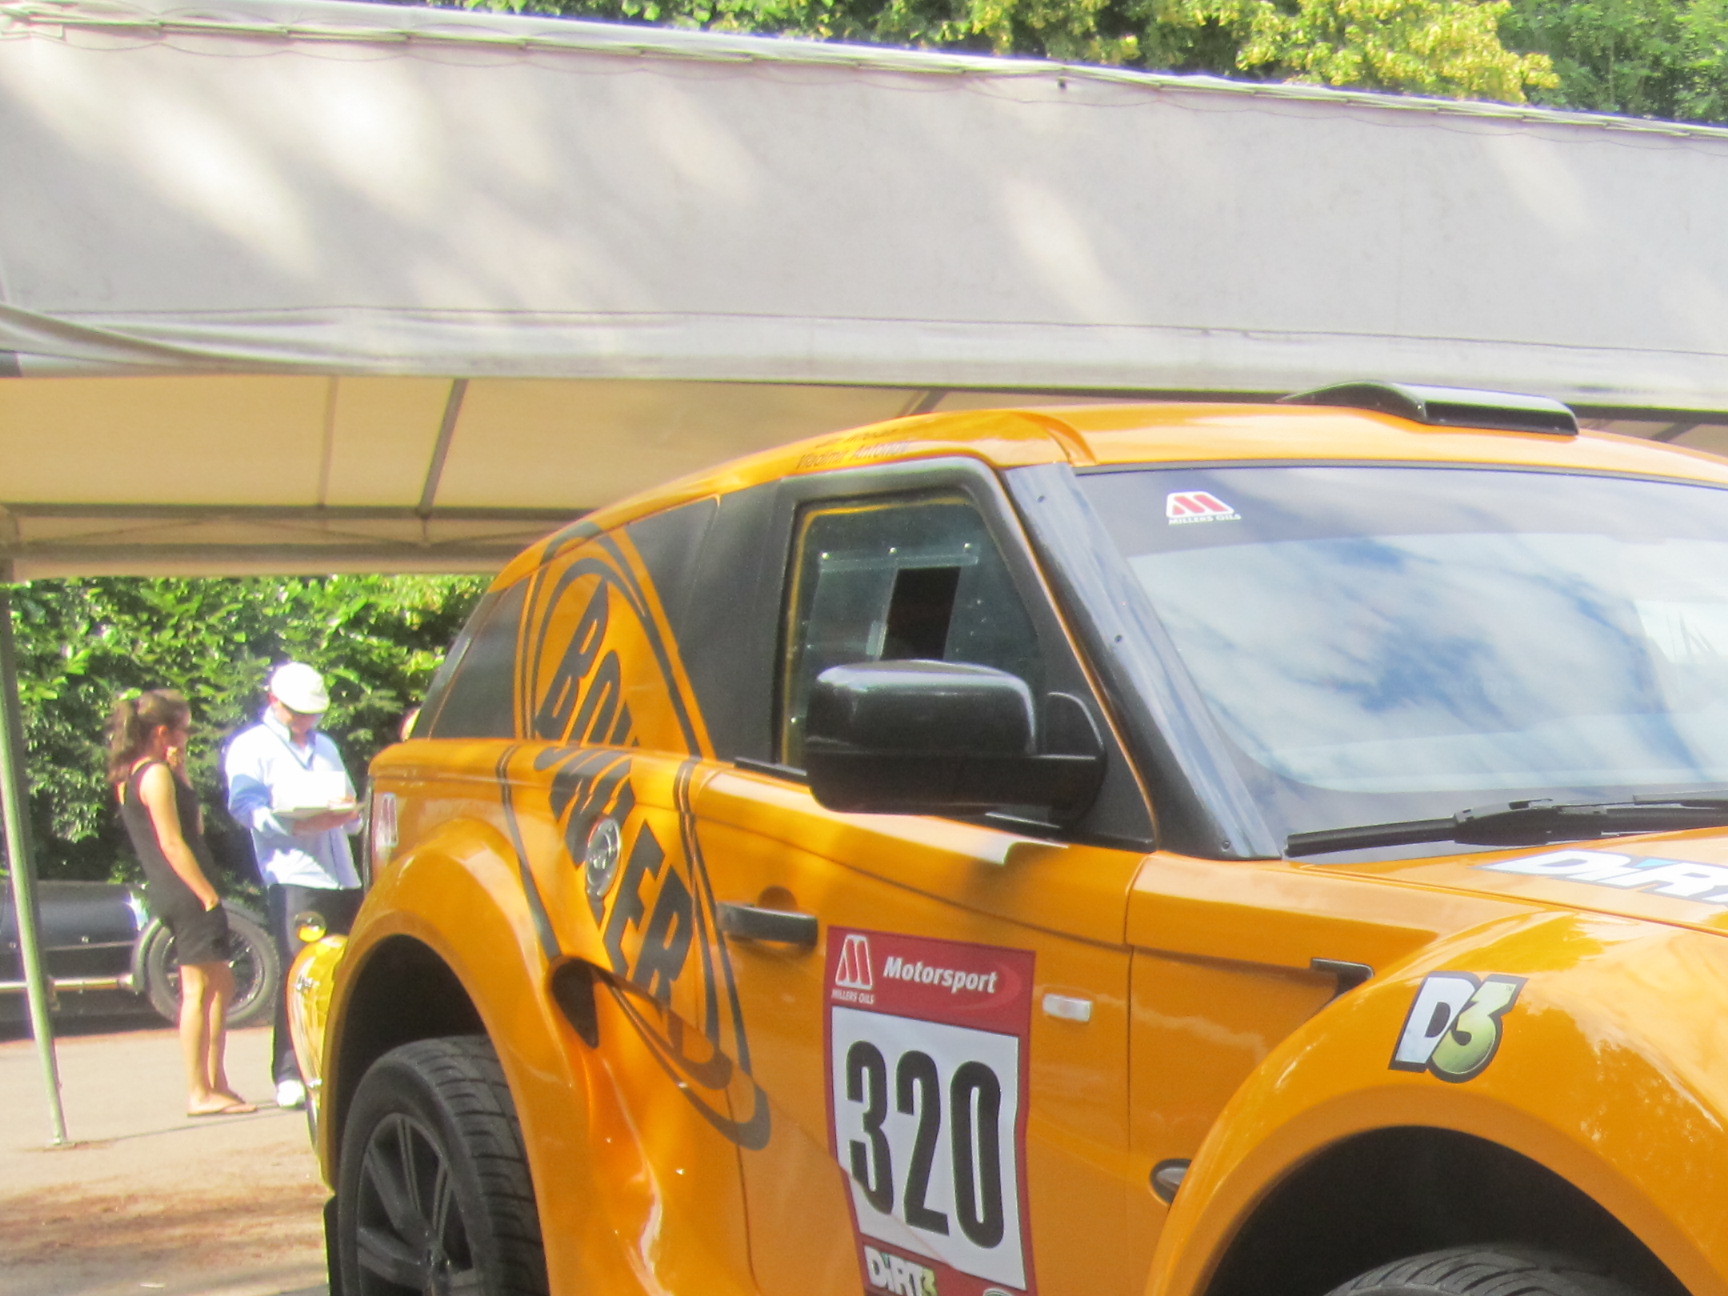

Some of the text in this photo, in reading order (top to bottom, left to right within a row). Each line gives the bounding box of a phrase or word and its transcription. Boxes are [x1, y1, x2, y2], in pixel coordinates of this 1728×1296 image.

[1168, 513, 1242, 525] MILLERS OILS
[883, 955, 999, 994] Motorsport
[831, 988, 875, 1005] MILLERS OILS
[845, 1040, 1004, 1249] 320
